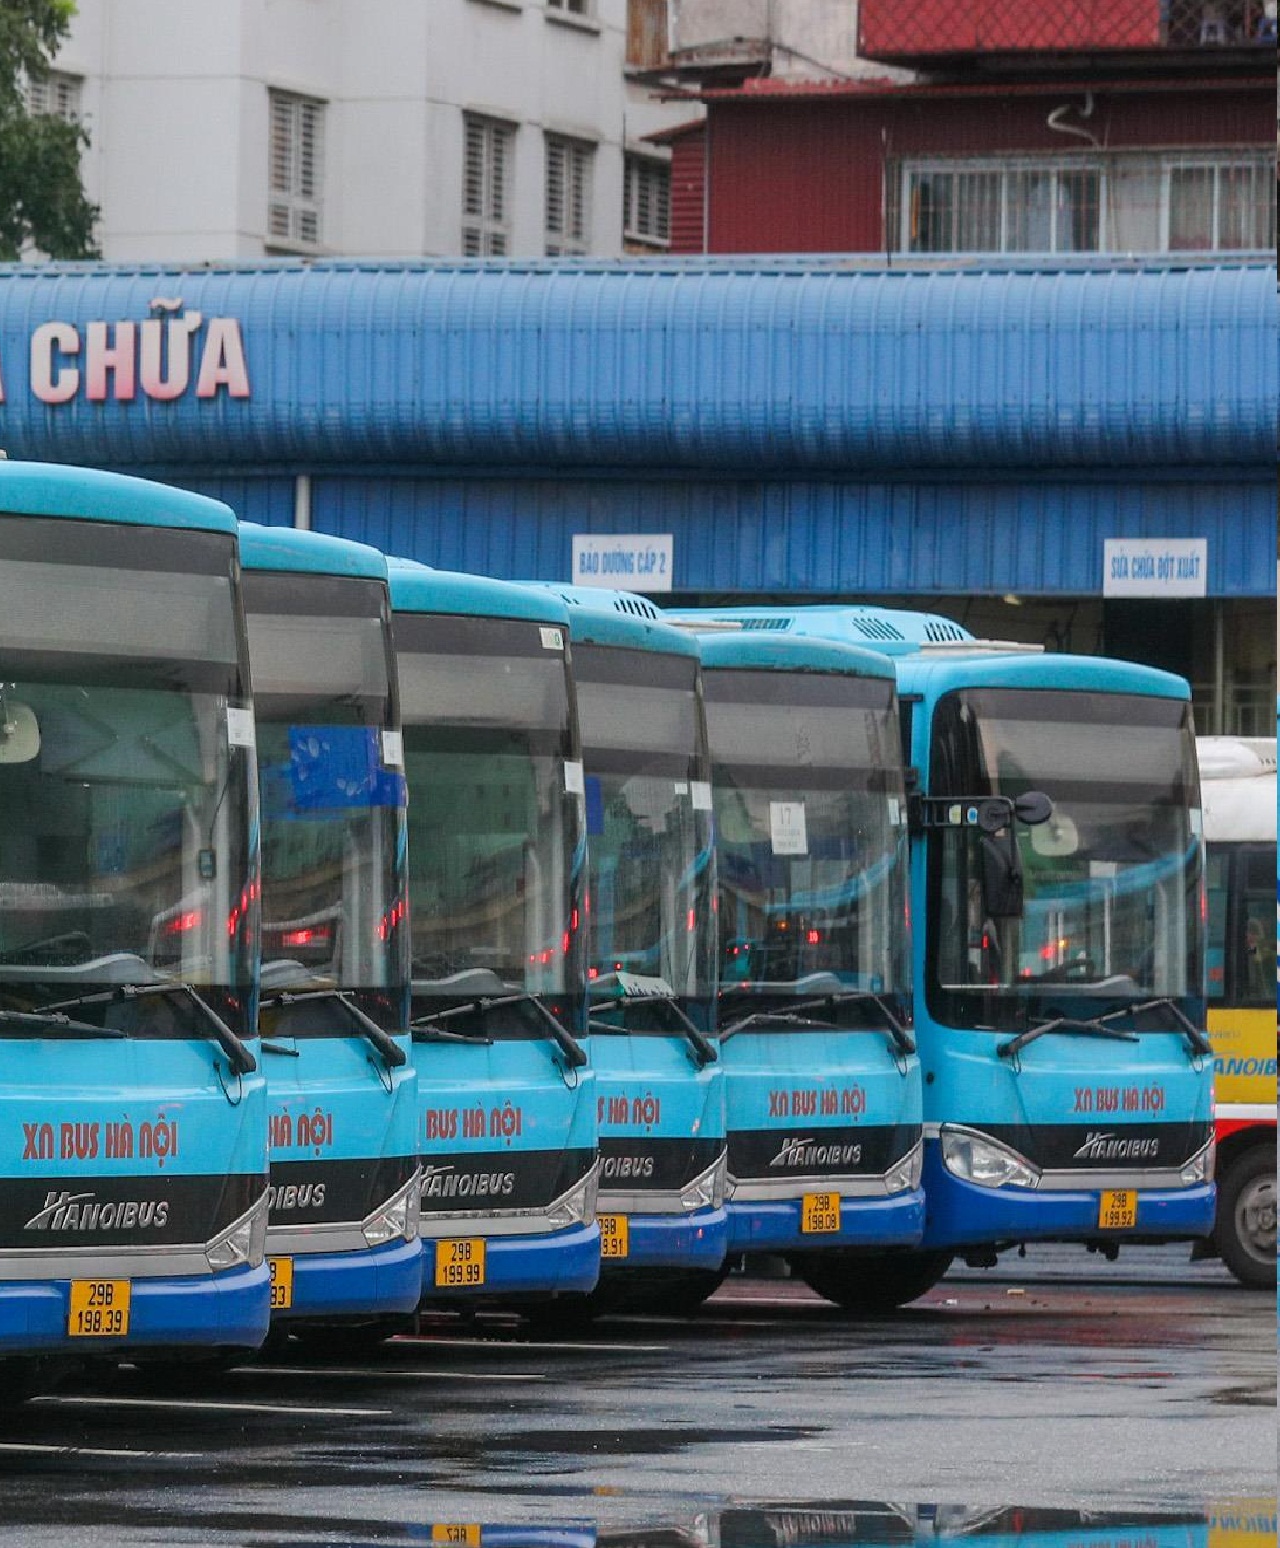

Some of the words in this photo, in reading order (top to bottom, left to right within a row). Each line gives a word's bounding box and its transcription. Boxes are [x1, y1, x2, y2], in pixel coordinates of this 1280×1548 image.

[30, 297, 251, 403] CHỮA
[658, 551, 666, 574] 2
[607, 1090, 628, 1124] HÀ
[632, 1090, 661, 1132] NỘI
[792, 1089, 818, 1117] BUS
[1096, 1087, 1120, 1113] BUS
[297, 1107, 333, 1157] NỘI
[425, 1108, 458, 1139] BUS
[462, 1100, 486, 1138] HÀ
[489, 1099, 522, 1147] NỘI
[60, 1122, 100, 1160] BUS
[105, 1113, 134, 1159] HÀ
[138, 1113, 177, 1168] NỘI
[769, 1137, 862, 1166] HANOIBUS
[1073, 1131, 1160, 1159] HANOIBUS
[23, 1191, 170, 1231] HANOIBUS
[451, 1242, 471, 1262] 29B
[442, 1264, 480, 1284] 199.99
[88, 1283, 114, 1306] 29B
[77, 1309, 123, 1333] 198.39
